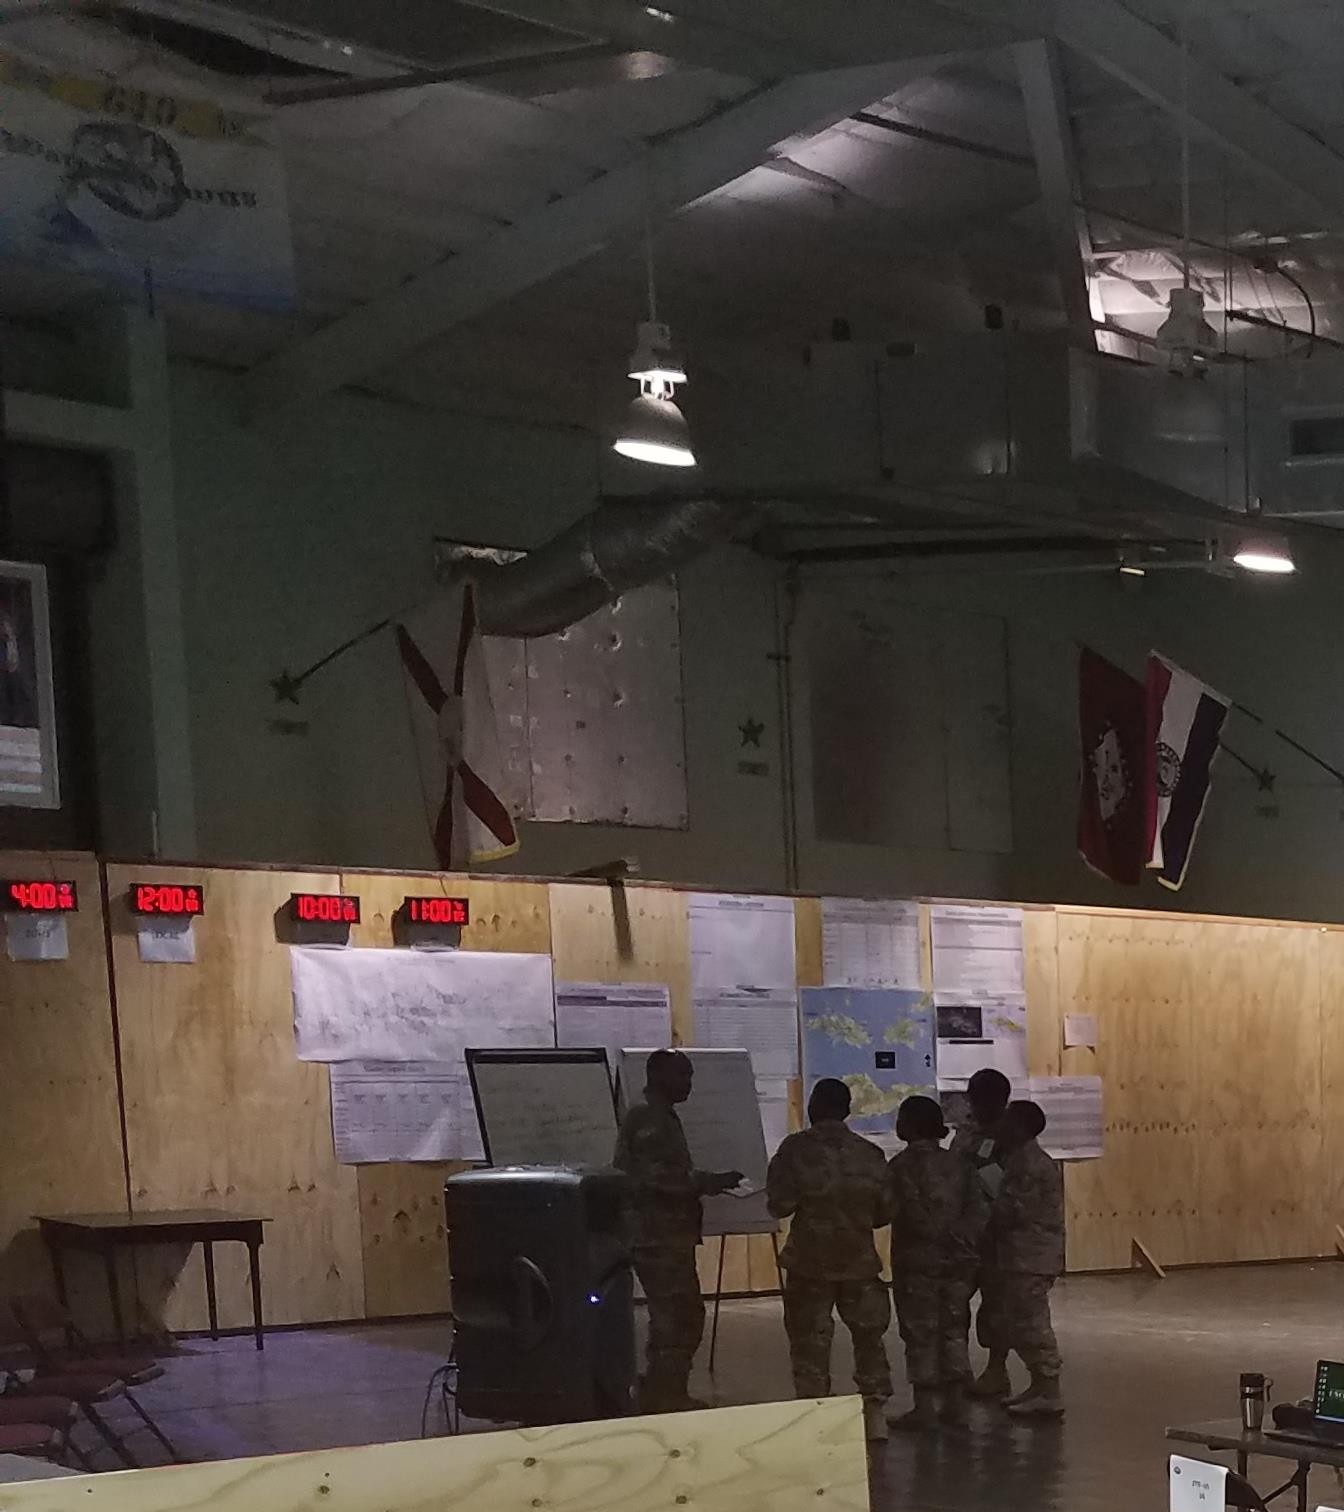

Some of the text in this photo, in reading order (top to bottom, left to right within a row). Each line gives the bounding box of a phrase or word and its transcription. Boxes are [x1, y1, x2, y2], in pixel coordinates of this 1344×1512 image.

[12, 883, 56, 909] 4:00
[138, 886, 184, 912] 12:00
[298, 896, 342, 920] 10:00
[411, 899, 451, 923] 11:00
